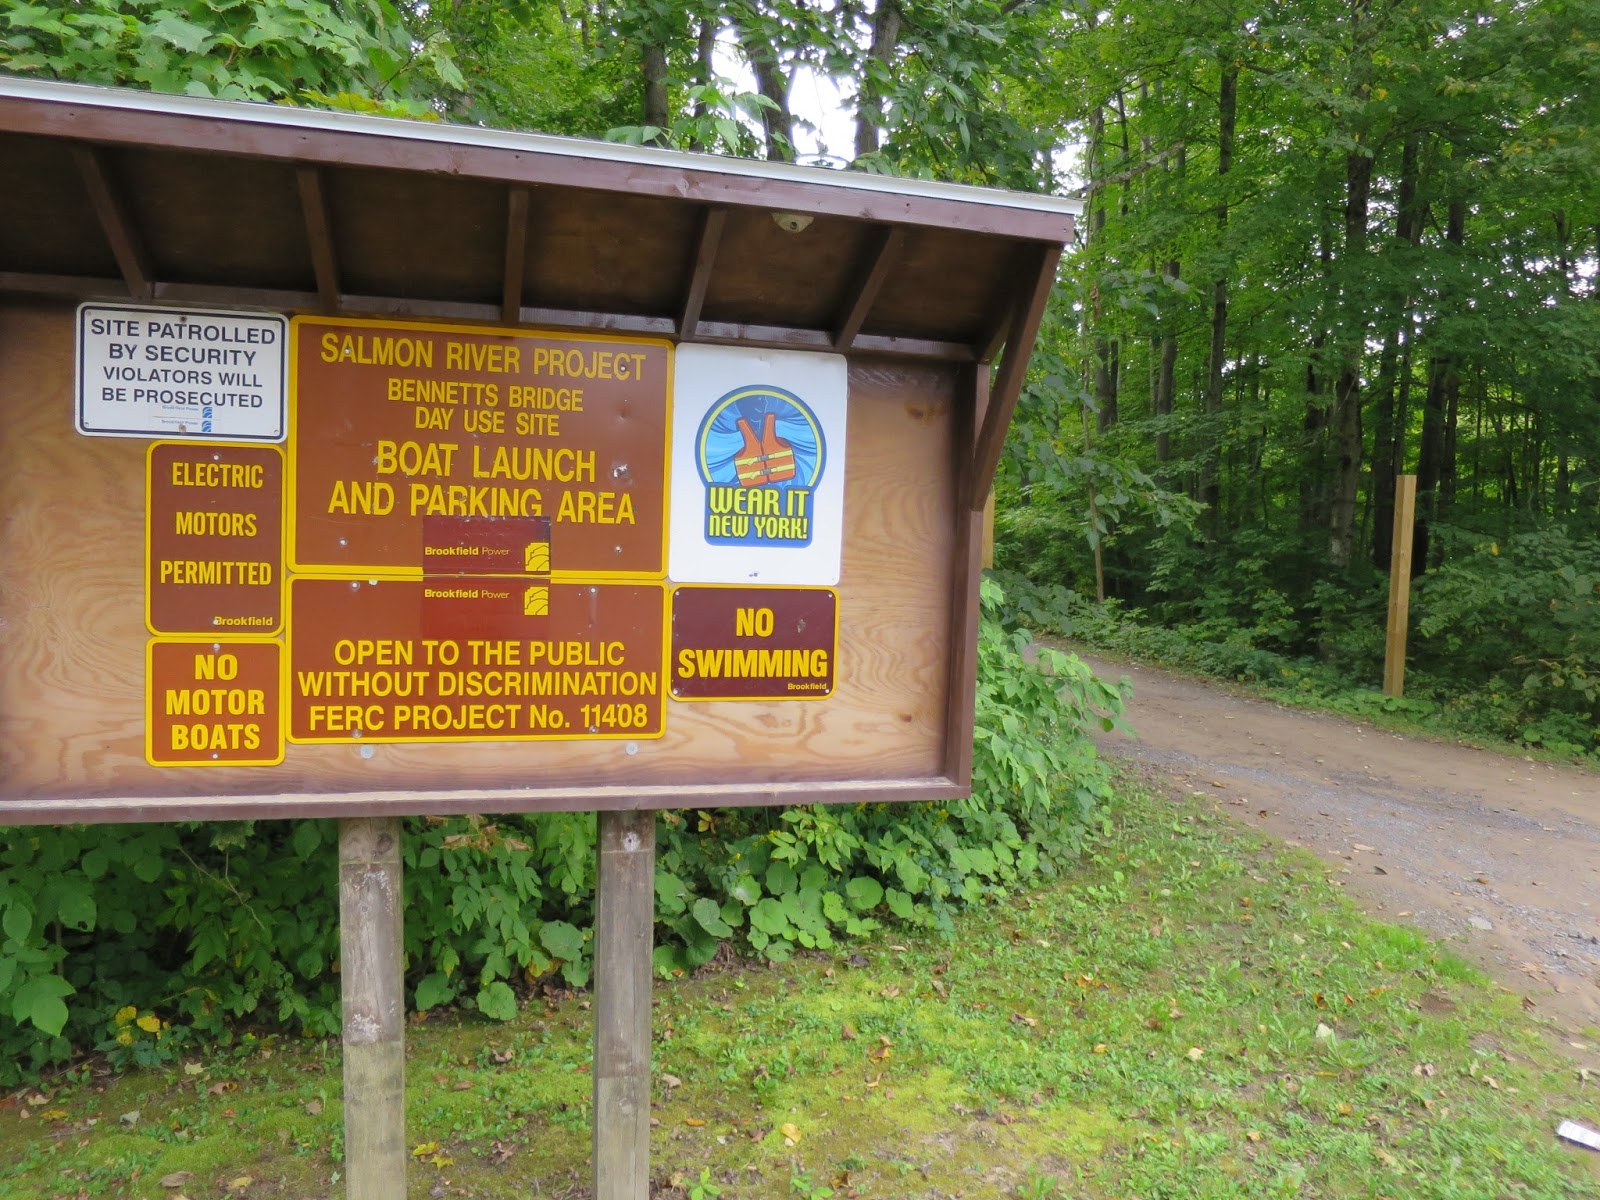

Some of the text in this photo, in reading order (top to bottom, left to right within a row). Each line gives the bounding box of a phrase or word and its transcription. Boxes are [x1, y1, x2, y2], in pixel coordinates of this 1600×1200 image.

[91, 318, 276, 345] SITE PATROLLED
[109, 343, 257, 366] BY SECURITY
[320, 332, 646, 381] SALMON RIVER PROJECT
[103, 366, 263, 388] VIOLATORS WILL
[102, 387, 263, 408] BE PROSECUTED
[388, 378, 584, 412] BENNETTS BRIDGE
[415, 406, 560, 437] DAY USE SITE
[376, 440, 596, 483] BOAT LAUNCH
[172, 462, 264, 489] ELECTRIC
[327, 480, 636, 525] AND PARKING AREA
[708, 487, 809, 518] WEAR IT
[175, 511, 257, 537] MOTORS
[708, 514, 809, 540] NEW YORK!
[424, 546, 510, 556] Brookfield Power
[160, 560, 272, 586] PERMITTED
[424, 588, 510, 599] Brookfield Power
[213, 616, 273, 626] Brookfield
[735, 607, 774, 638] NO
[334, 639, 625, 666] OPEN TO THE PUBLIC
[677, 648, 828, 679] SWIMMING
[194, 654, 238, 681] NO
[297, 671, 657, 697] WITHOUT DISCRIMINATION
[787, 682, 827, 691] Brookfield
[165, 689, 265, 716] MOTOR
[309, 703, 648, 731] FERC PROJECT No. 11408
[171, 724, 260, 751] BOATS
